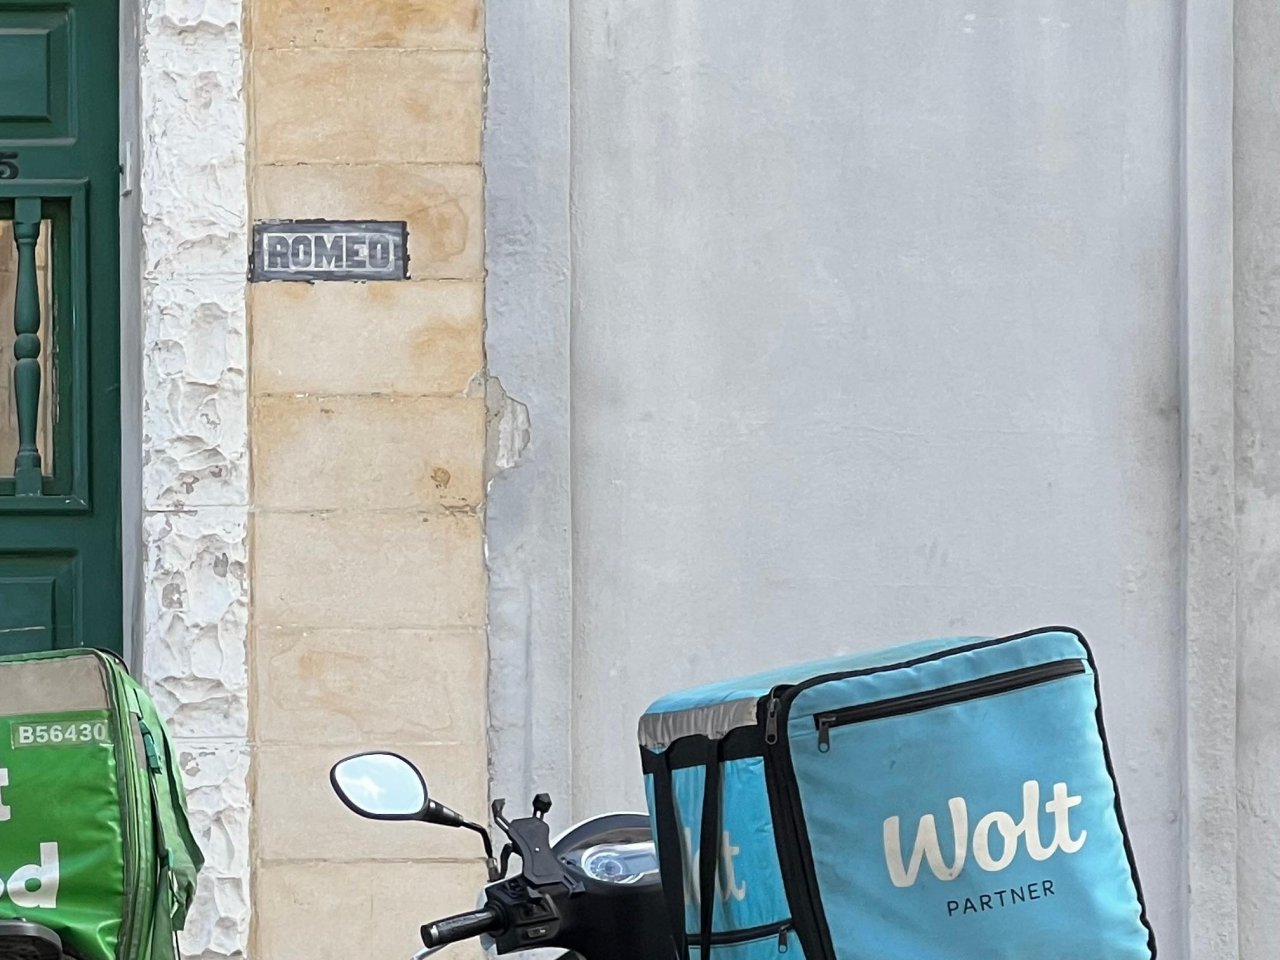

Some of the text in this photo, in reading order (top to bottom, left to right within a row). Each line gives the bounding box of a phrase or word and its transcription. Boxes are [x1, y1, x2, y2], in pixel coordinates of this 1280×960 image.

[267, 234, 390, 269] ROMEO
[18, 722, 107, 744] B56430
[882, 780, 1088, 888] Wolt
[946, 879, 1056, 917] PARTNER
